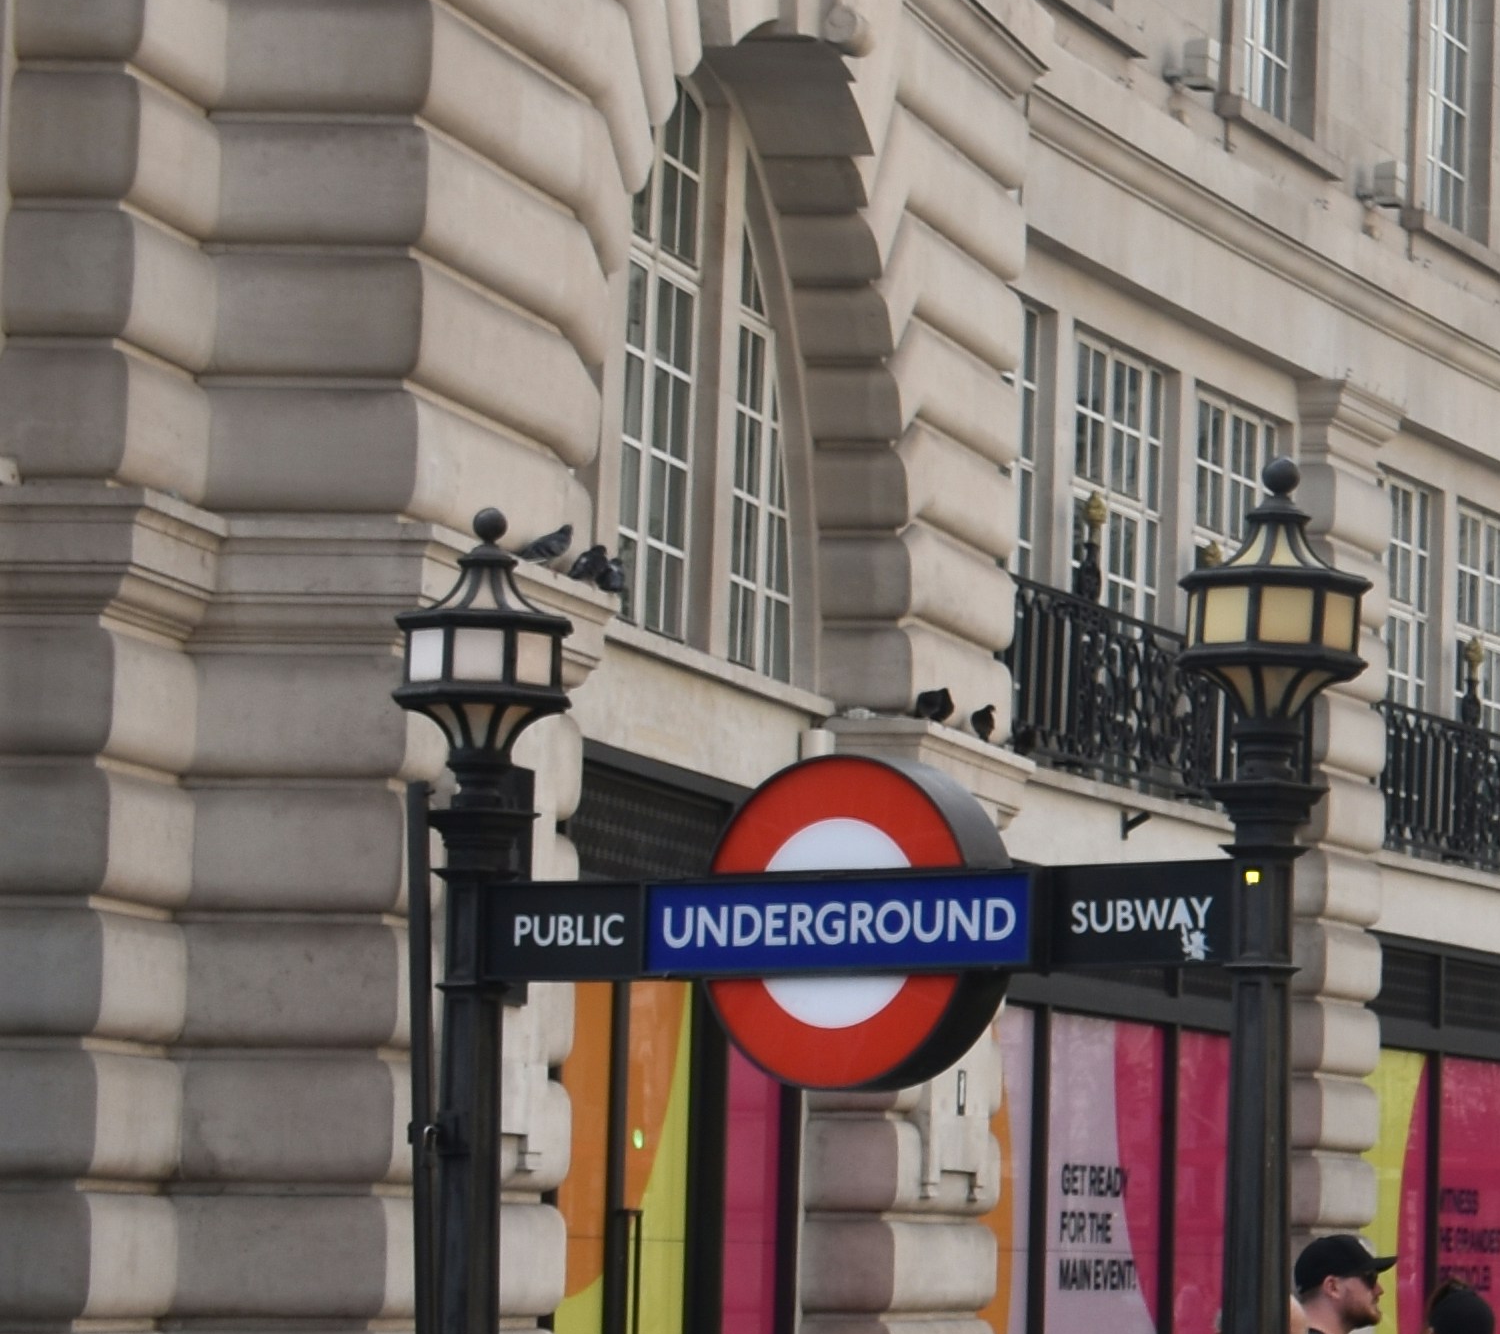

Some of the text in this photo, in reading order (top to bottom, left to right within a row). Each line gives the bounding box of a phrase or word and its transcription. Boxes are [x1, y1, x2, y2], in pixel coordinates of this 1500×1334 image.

[513, 913, 625, 948] PUBLIC
[662, 897, 1017, 949] UNDERGROUND
[1070, 895, 1213, 935] SUBWAY
[1061, 1163, 1128, 1198] GET READY
[1440, 1188, 1479, 1216] ITNESS
[1060, 1211, 1112, 1244] FOR THE
[1059, 1259, 1091, 1290] MAIN
